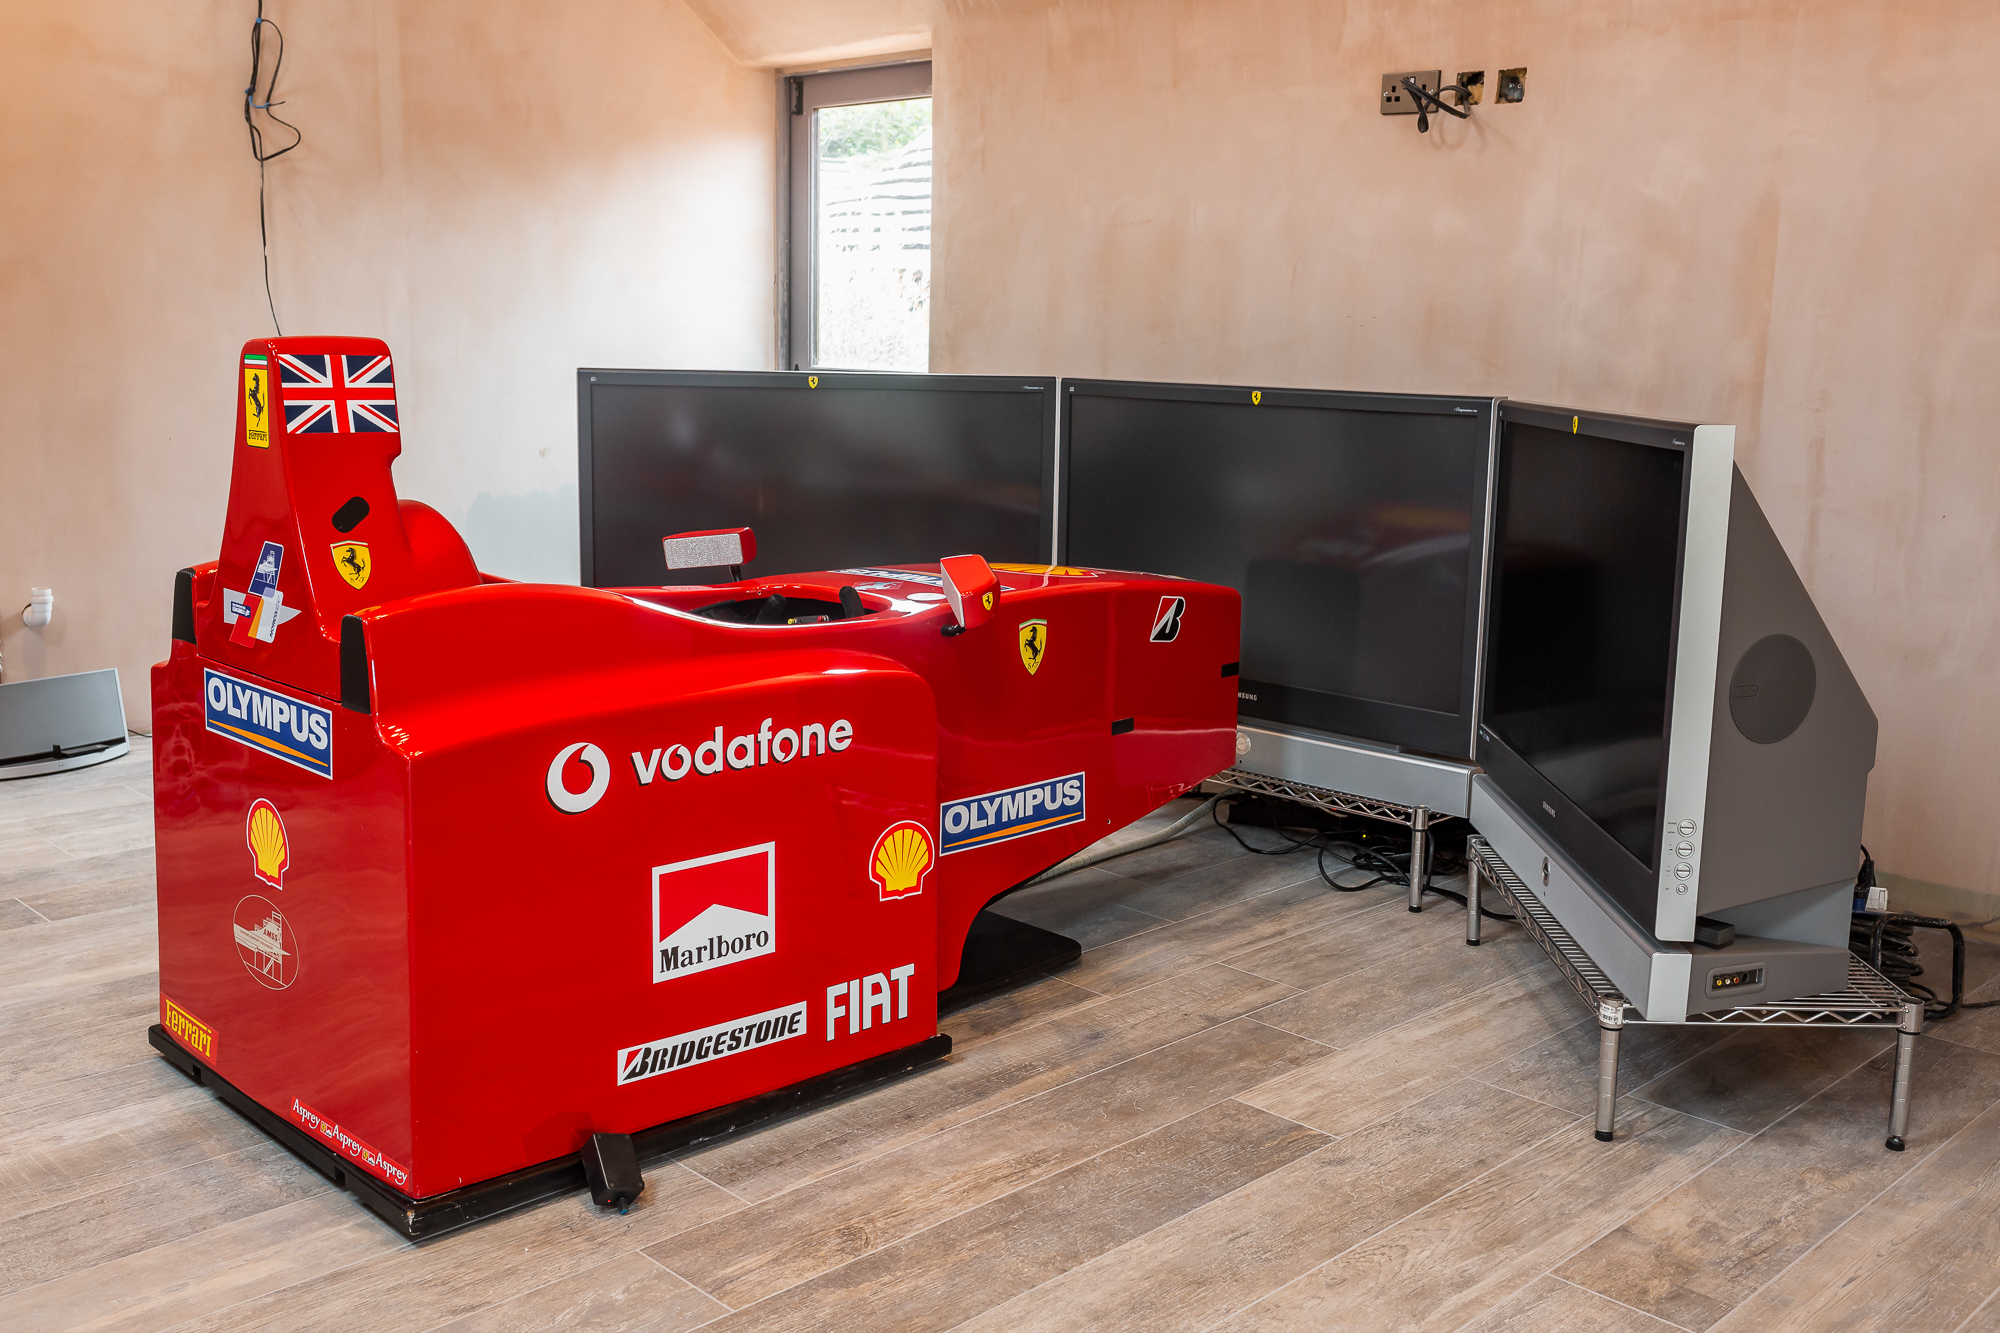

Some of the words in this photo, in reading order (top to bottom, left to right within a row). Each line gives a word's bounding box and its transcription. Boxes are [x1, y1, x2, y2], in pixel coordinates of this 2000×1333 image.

[249, 430, 268, 441] Ferrari
[208, 677, 328, 750] OLYMPUS
[631, 718, 853, 785] vodafone
[944, 779, 1082, 834] OLYMPUS
[263, 928, 278, 941] AMSS
[659, 929, 769, 974] Marlboro
[165, 998, 212, 1058] Ferrari
[826, 963, 915, 1042] FIAT
[622, 1010, 803, 1081] BRIDGESTONE
[292, 1098, 321, 1129] Asprey
[332, 1124, 363, 1157] Asprey
[375, 1152, 408, 1186] Asprey
